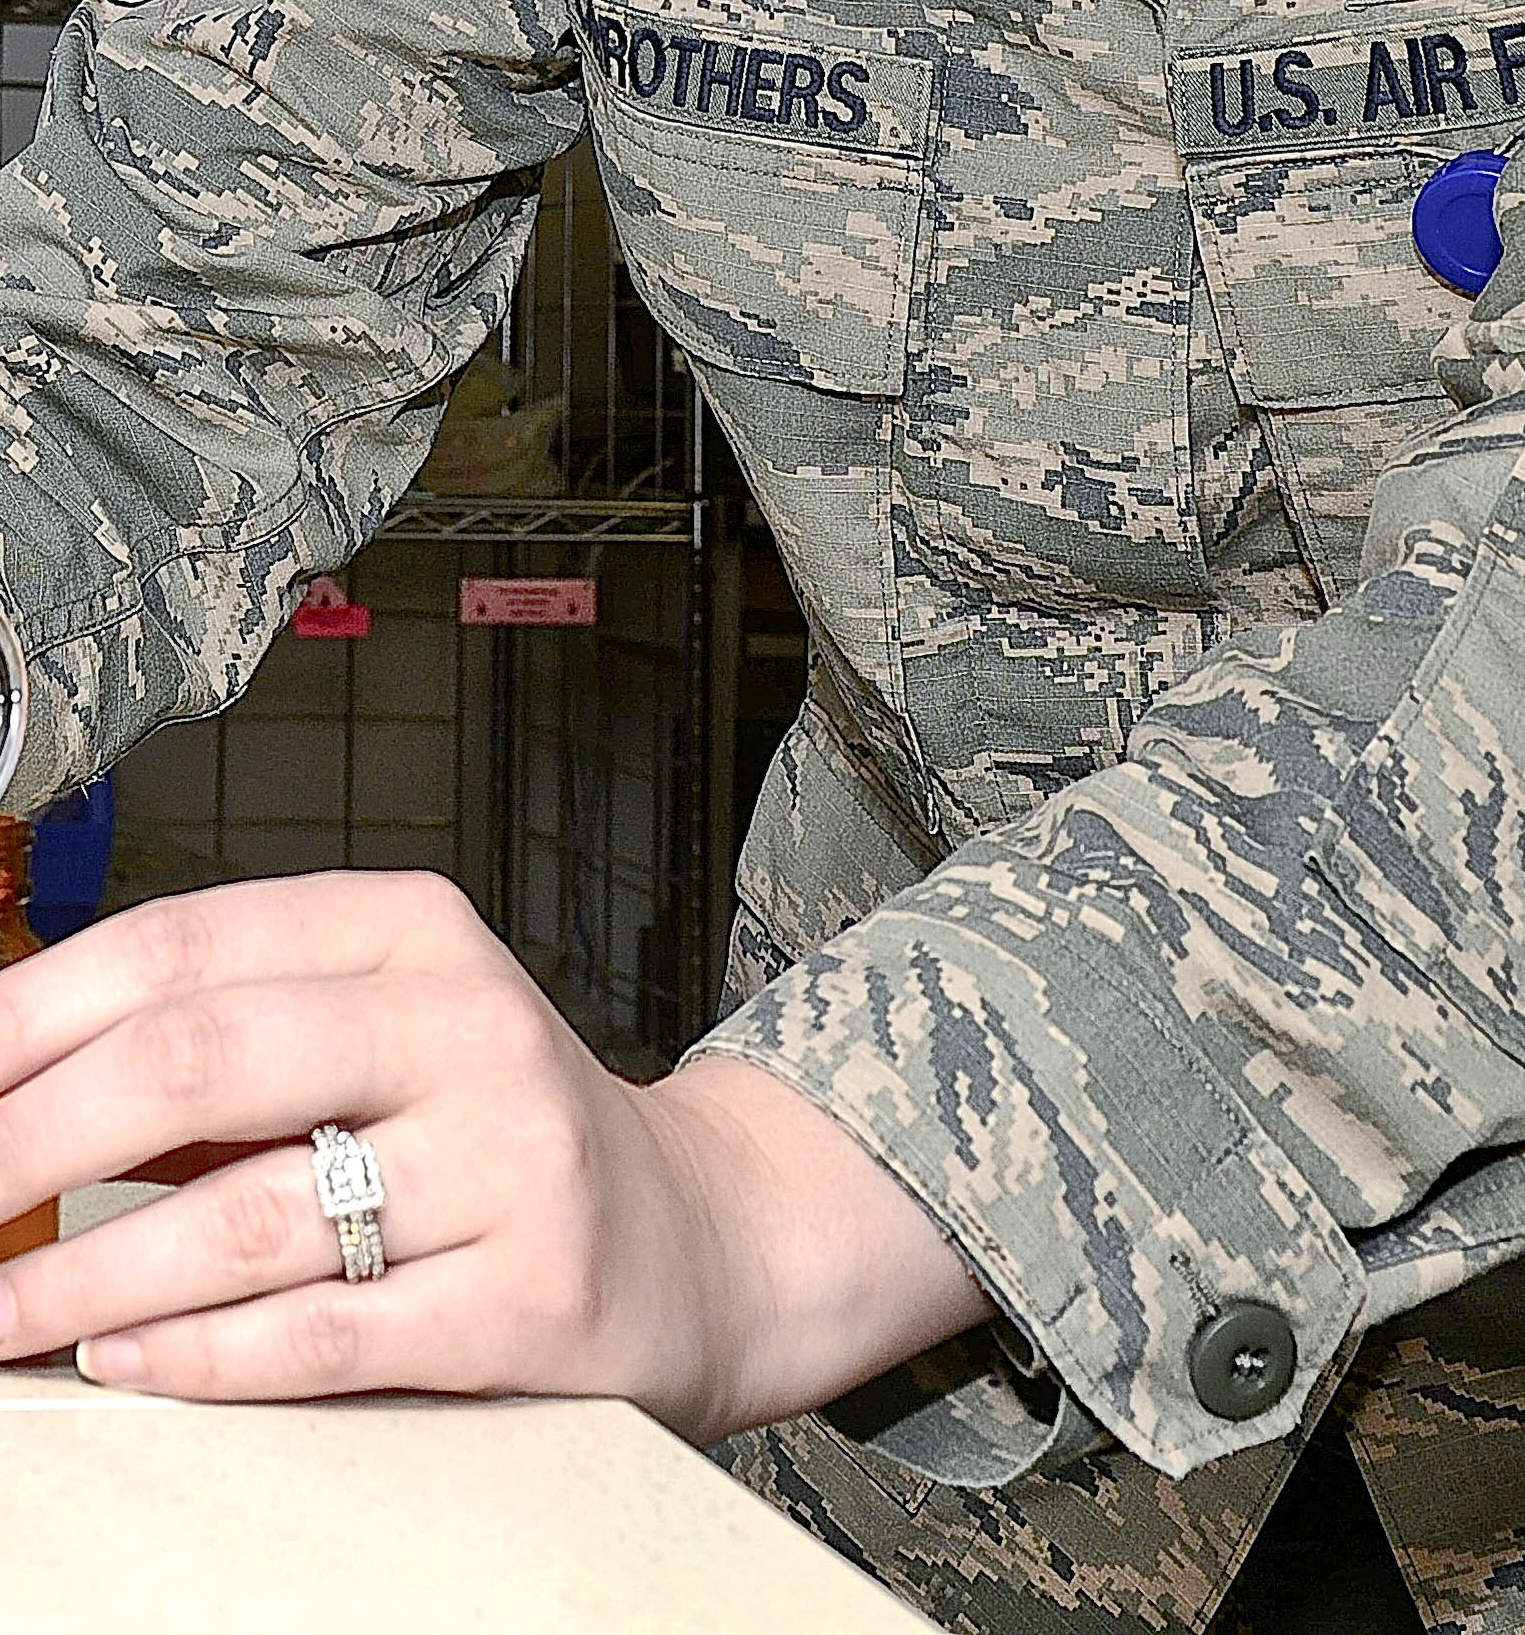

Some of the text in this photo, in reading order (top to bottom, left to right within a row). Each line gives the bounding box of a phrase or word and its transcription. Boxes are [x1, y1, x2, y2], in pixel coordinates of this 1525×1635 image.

[586, 16, 870, 133] ROTHERS
[1210, 51, 1337, 136] U.S.
[1363, 33, 1477, 122] AIR
